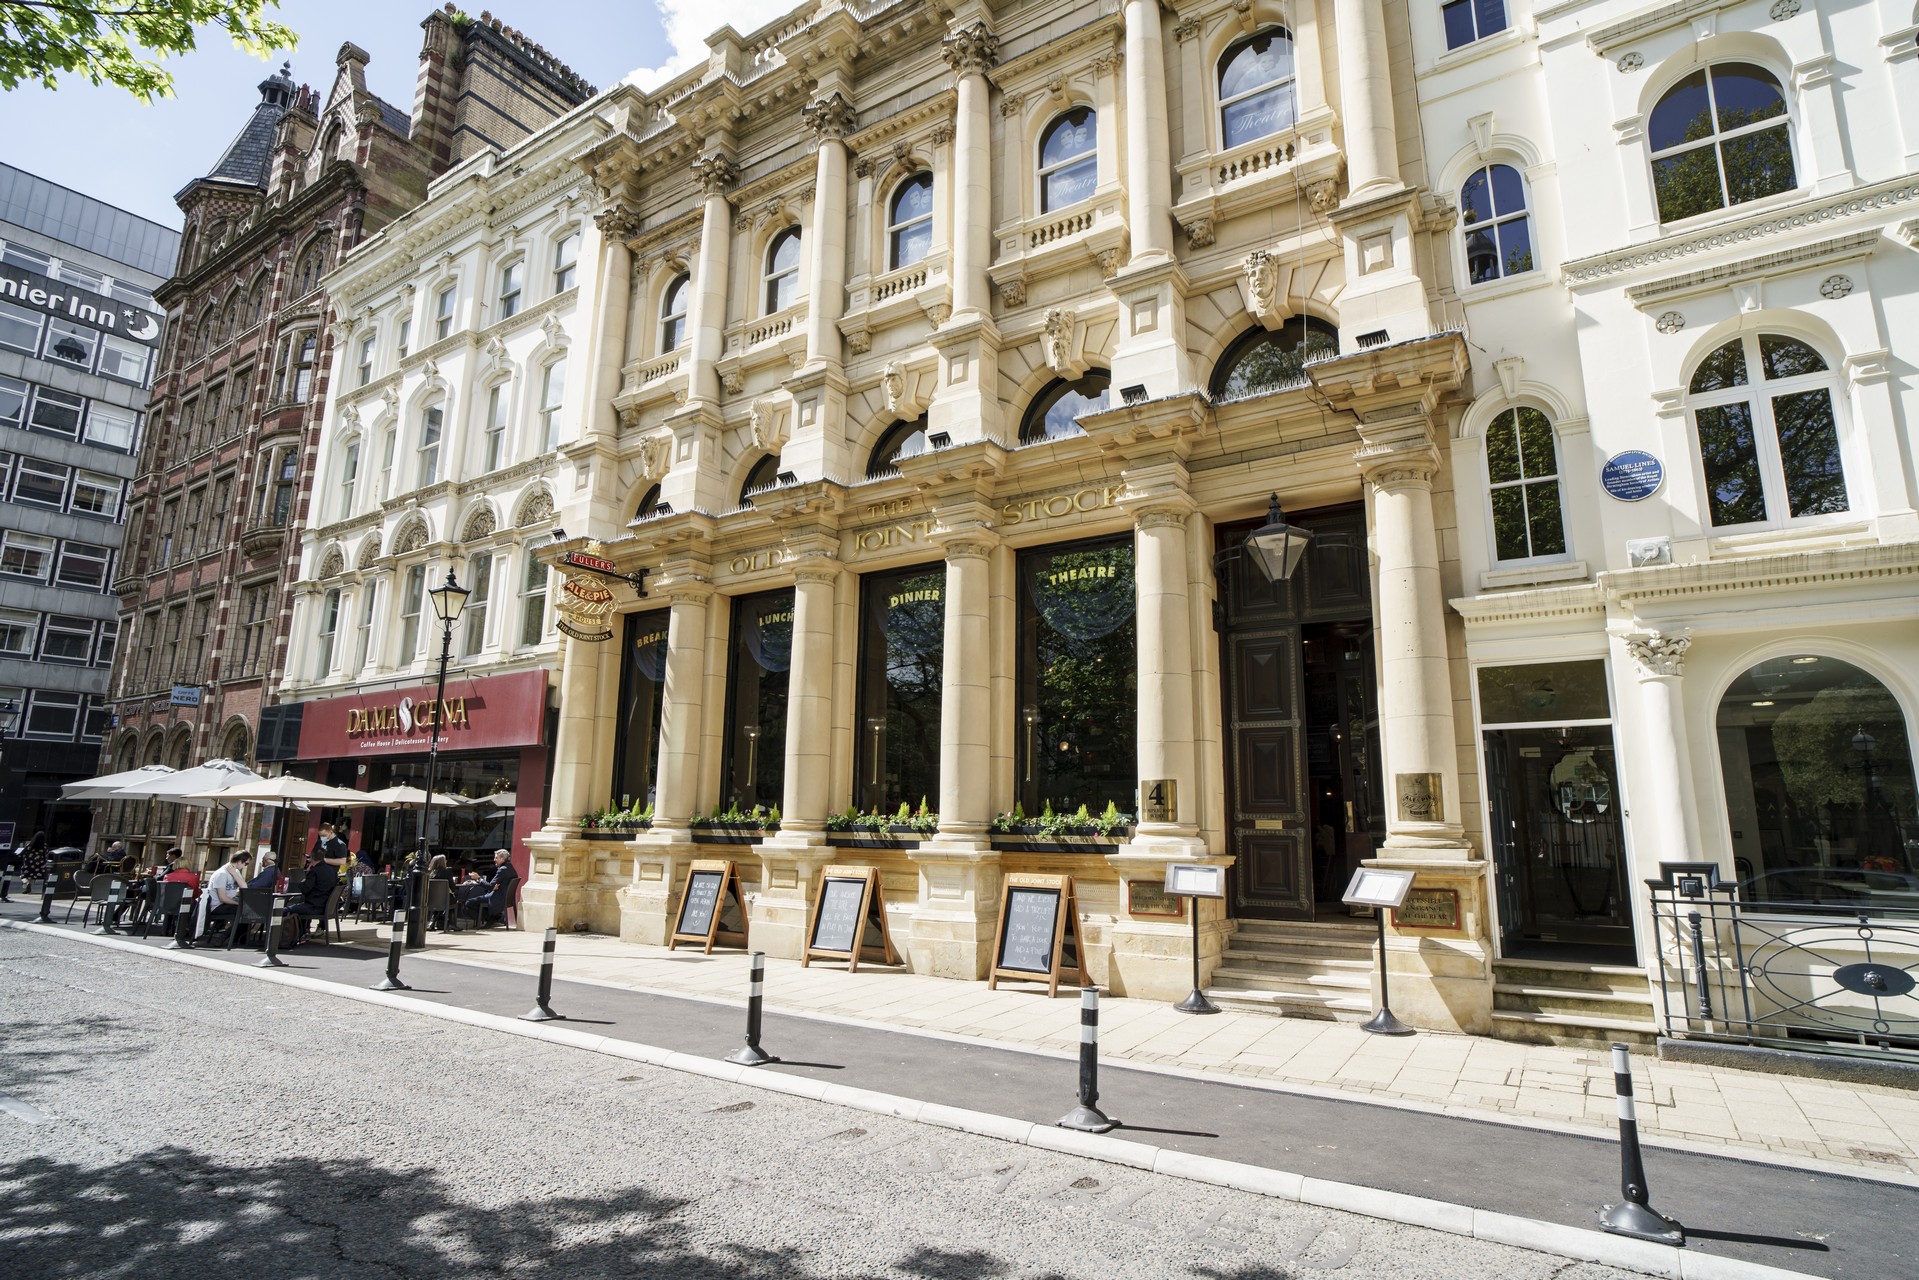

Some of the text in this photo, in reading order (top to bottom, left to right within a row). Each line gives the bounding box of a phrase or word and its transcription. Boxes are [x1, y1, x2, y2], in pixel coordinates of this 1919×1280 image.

[69, 296, 116, 328] Inn
[1606, 464, 1634, 472] SAMUEL
[867, 499, 912, 518] THE
[729, 483, 1124, 575] OLD JOINT STOCK
[1050, 565, 1115, 585] THEATRE
[890, 589, 940, 607] DINNER
[559, 620, 568, 633] THE
[568, 629, 579, 638] OLD
[759, 612, 794, 627] LUNCH
[345, 696, 467, 733] DAMASCENA
[395, 738, 425, 746] Delicatessen
[1148, 783, 1165, 806] 4
